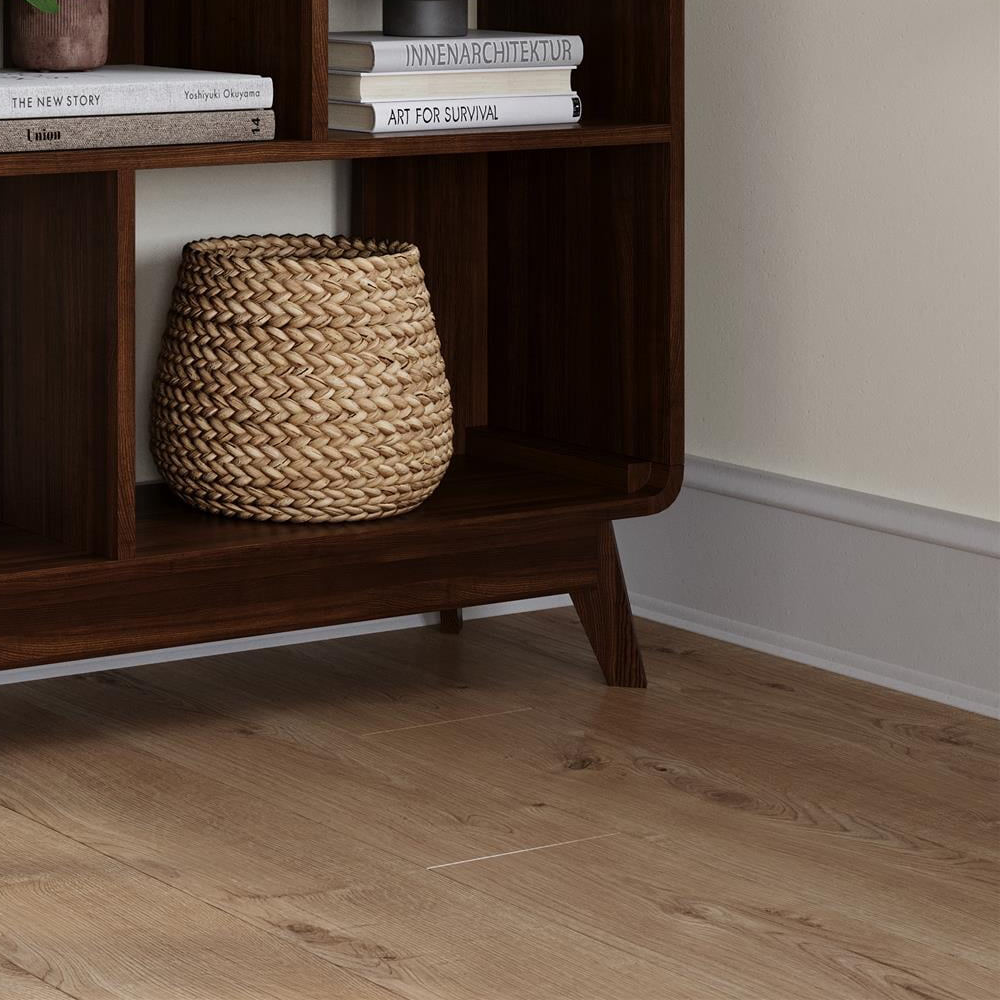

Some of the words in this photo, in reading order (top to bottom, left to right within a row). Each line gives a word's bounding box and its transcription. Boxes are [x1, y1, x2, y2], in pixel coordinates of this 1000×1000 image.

[405, 39, 572, 67] INNENARCHITEKTUR
[12, 97, 33, 109] THE
[37, 96, 63, 108] NEW
[66, 94, 101, 106] STORY
[184, 89, 222, 102] Yoshiyuki
[223, 88, 260, 100] Okuyama
[388, 108, 410, 125] ART
[415, 106, 440, 124] FOR
[444, 105, 499, 122] SURVIVAL
[250, 117, 261, 135] 14
[26, 128, 61, 141] Union
